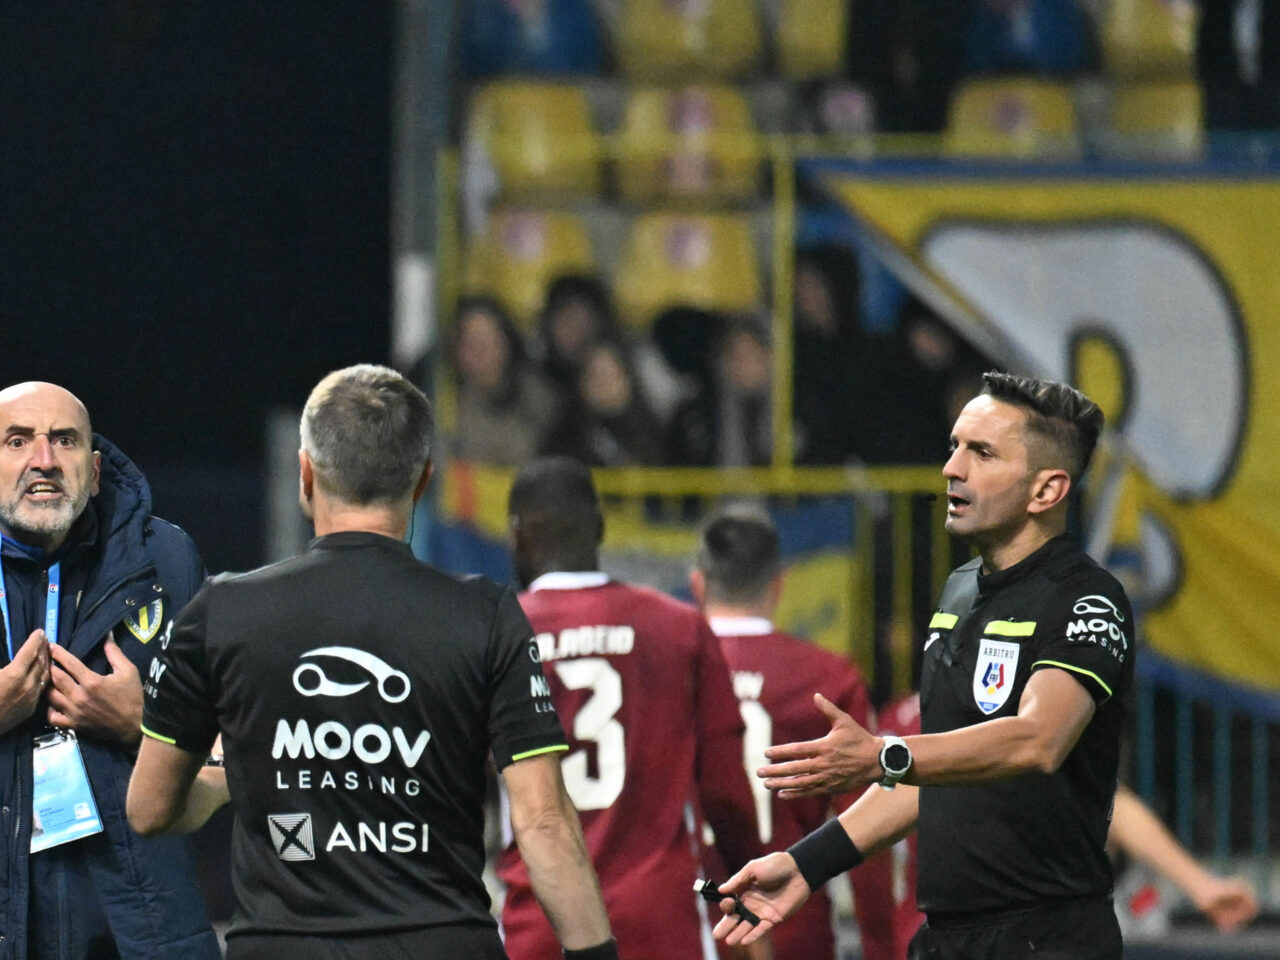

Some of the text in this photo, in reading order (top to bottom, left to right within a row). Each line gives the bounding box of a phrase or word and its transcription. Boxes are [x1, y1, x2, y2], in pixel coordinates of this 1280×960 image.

[983, 647, 1015, 660] ARBITRU
[271, 718, 431, 768] MOOV
[556, 659, 625, 810] 3
[276, 770, 420, 796] LEASING
[326, 822, 429, 853] ANSI
